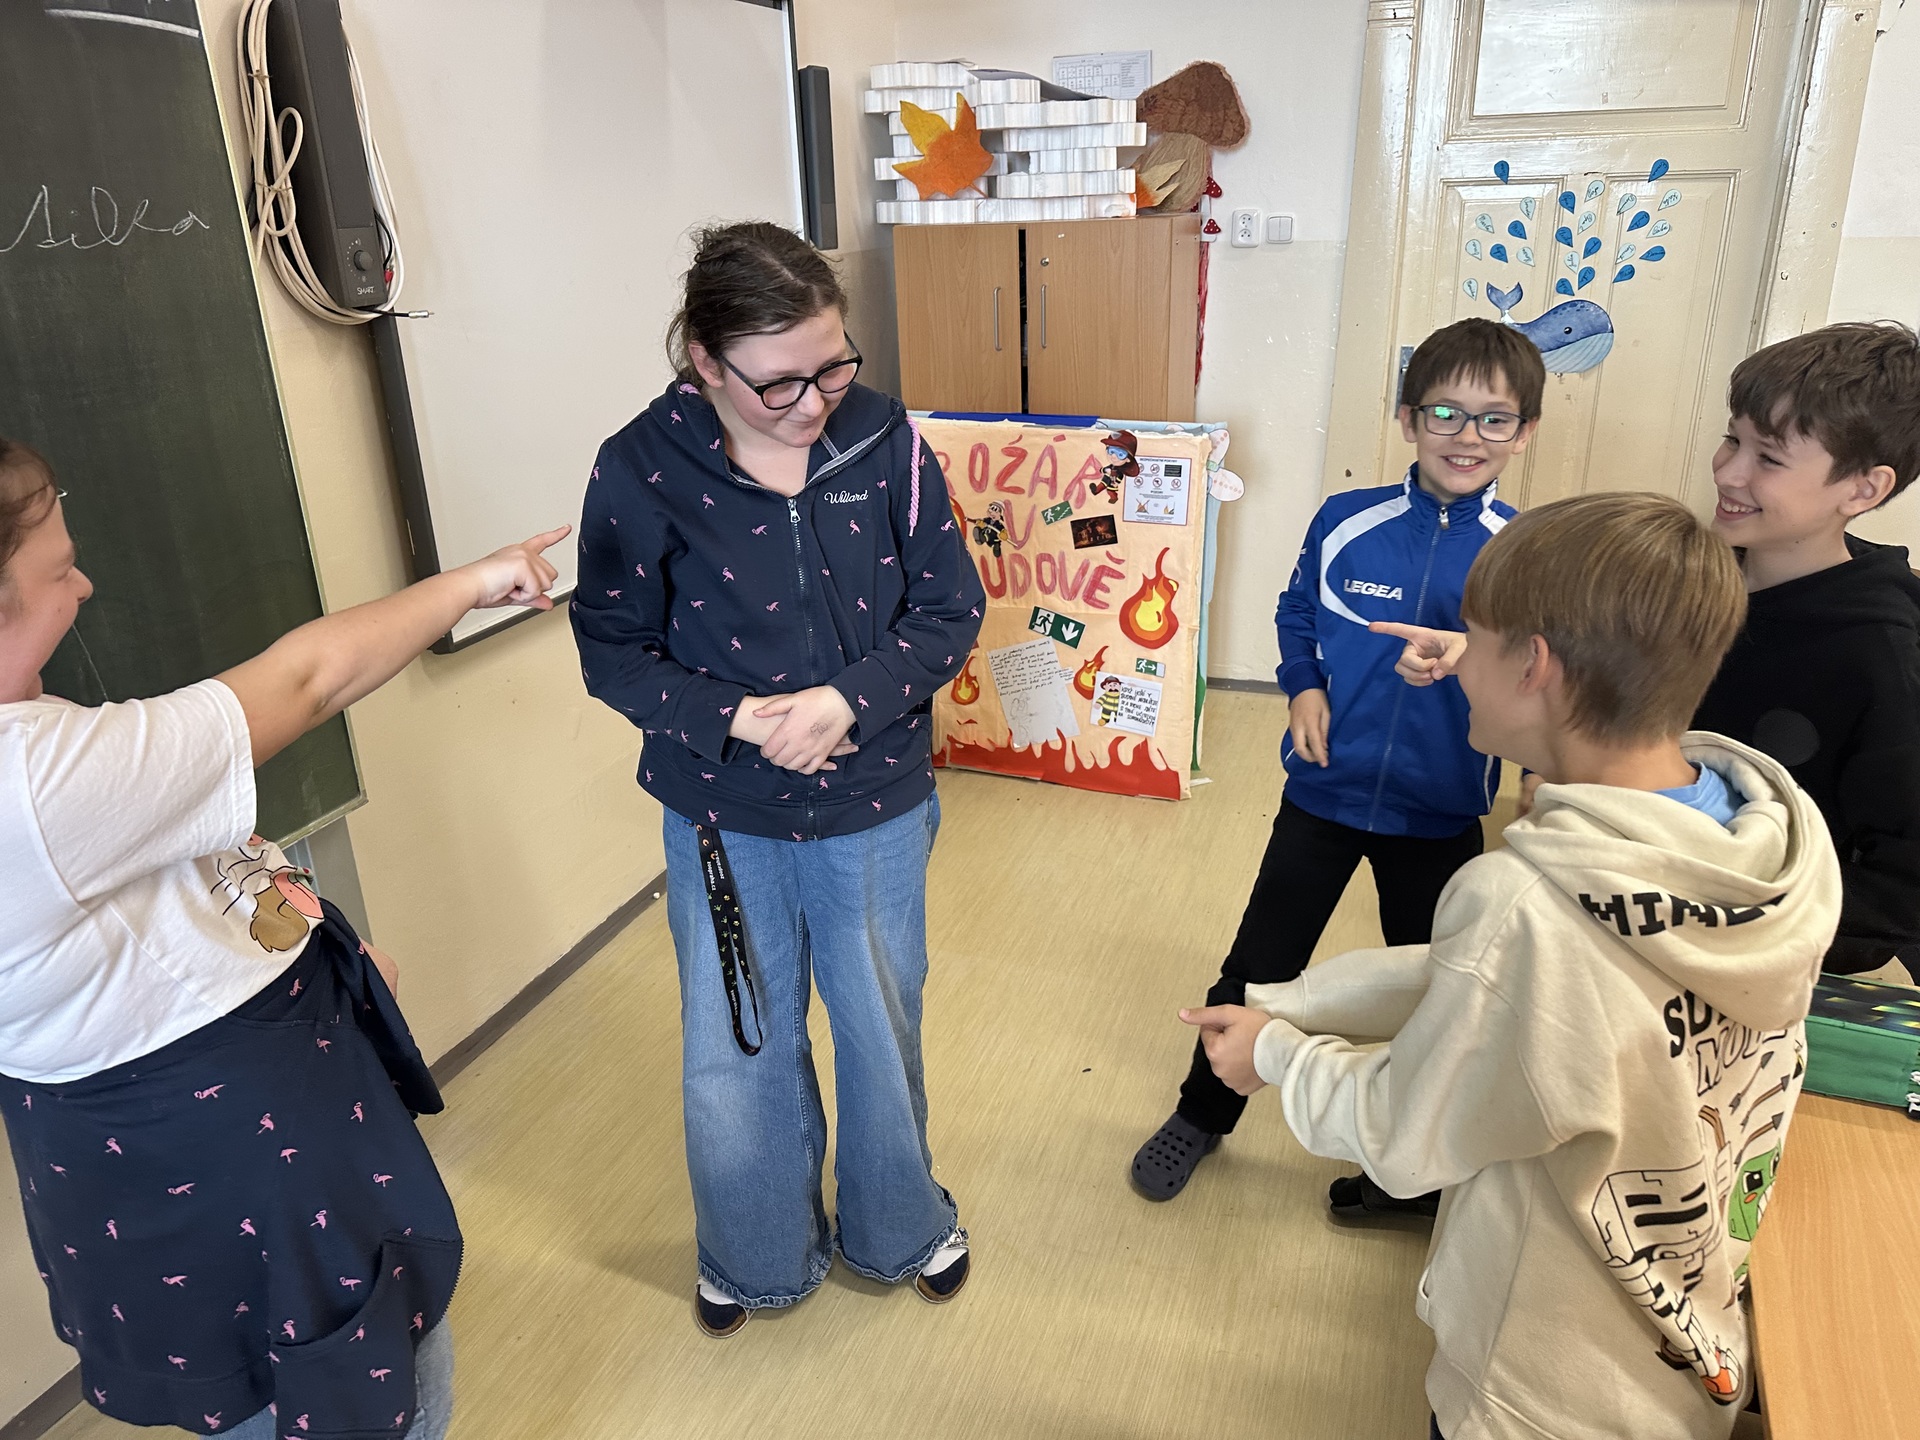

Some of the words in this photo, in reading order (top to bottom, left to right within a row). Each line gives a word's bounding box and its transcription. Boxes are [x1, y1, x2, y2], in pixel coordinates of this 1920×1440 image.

[823, 488, 869, 504] Willard
[980, 550, 1126, 610] UDOVĚ
[1343, 578, 1403, 601] LEGEA
